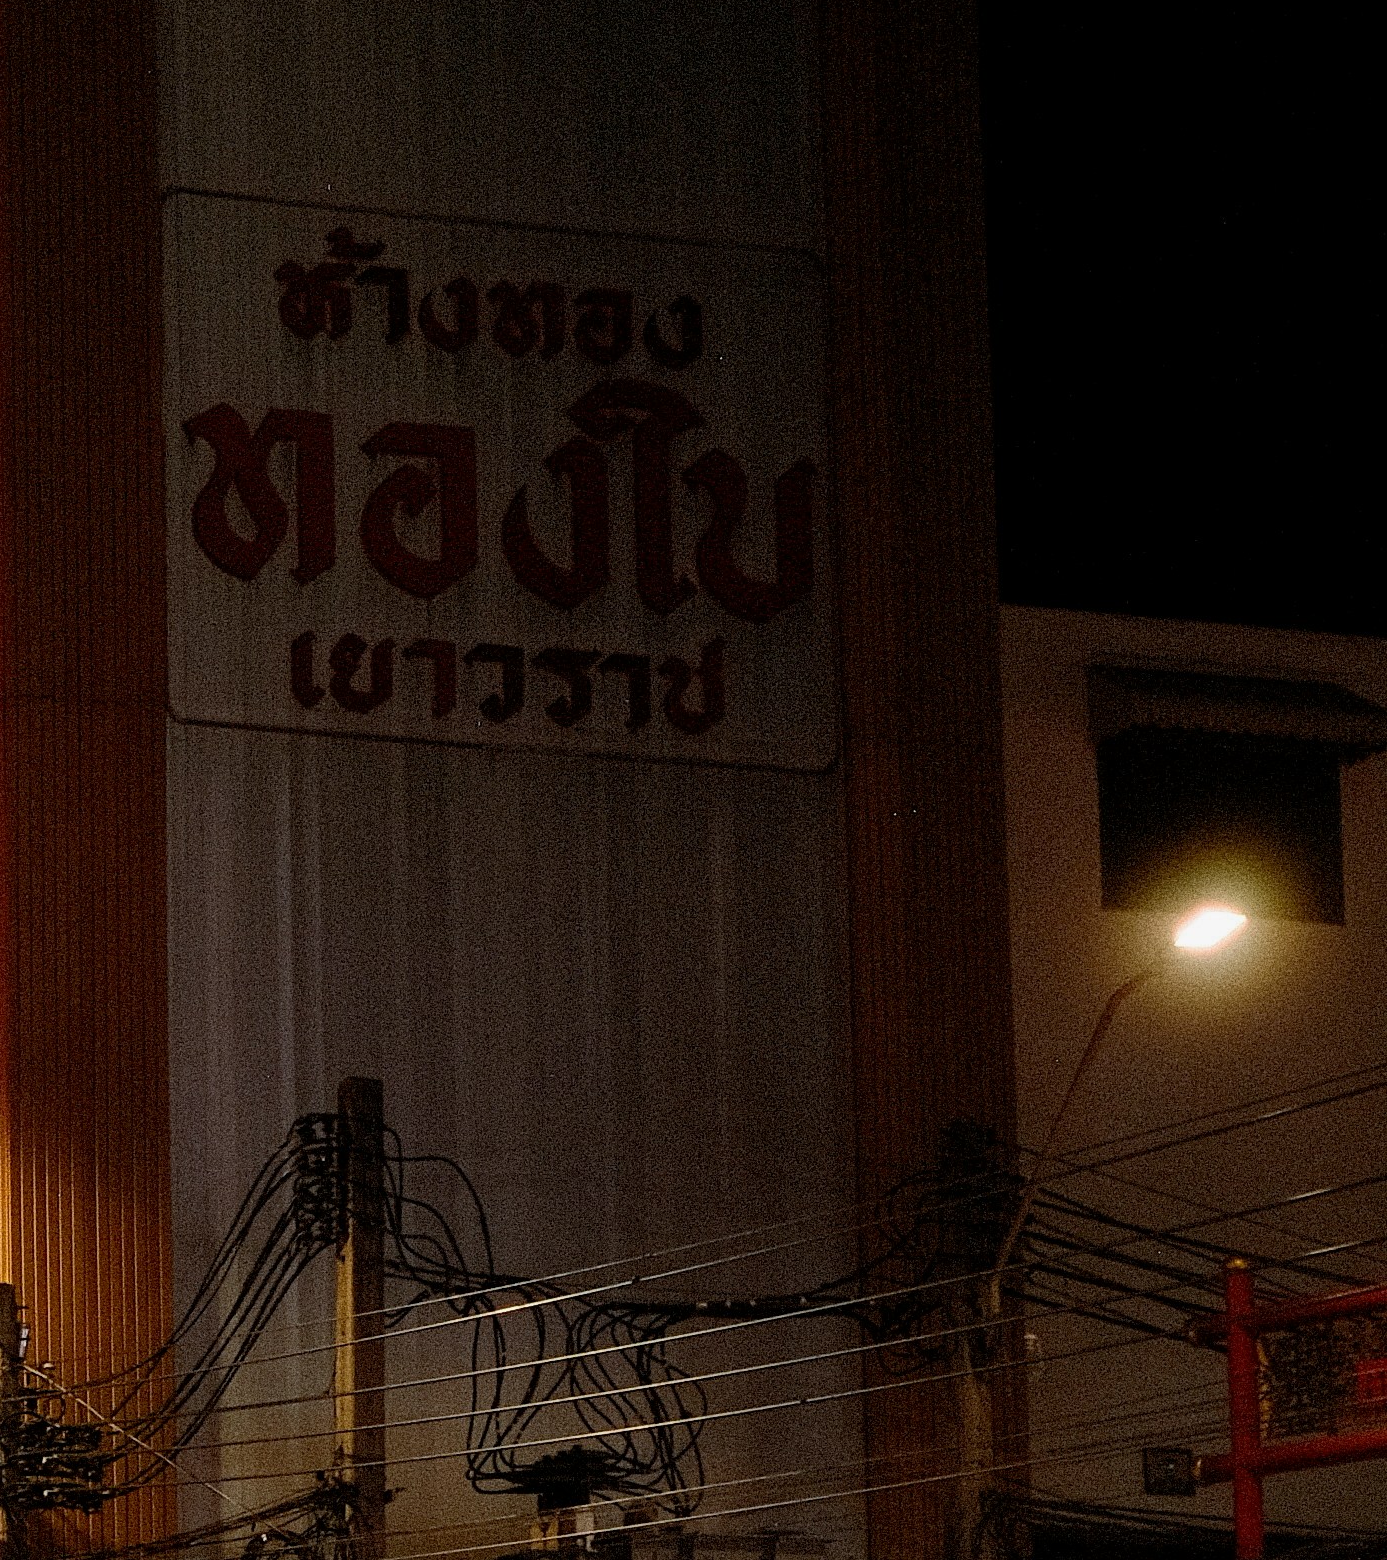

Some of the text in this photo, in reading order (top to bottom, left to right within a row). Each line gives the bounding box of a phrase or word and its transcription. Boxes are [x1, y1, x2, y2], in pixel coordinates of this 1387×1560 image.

[273, 226, 704, 371] ห้างทอง
[181, 378, 819, 625] ทองใบ
[289, 630, 729, 736] เยาวราช
